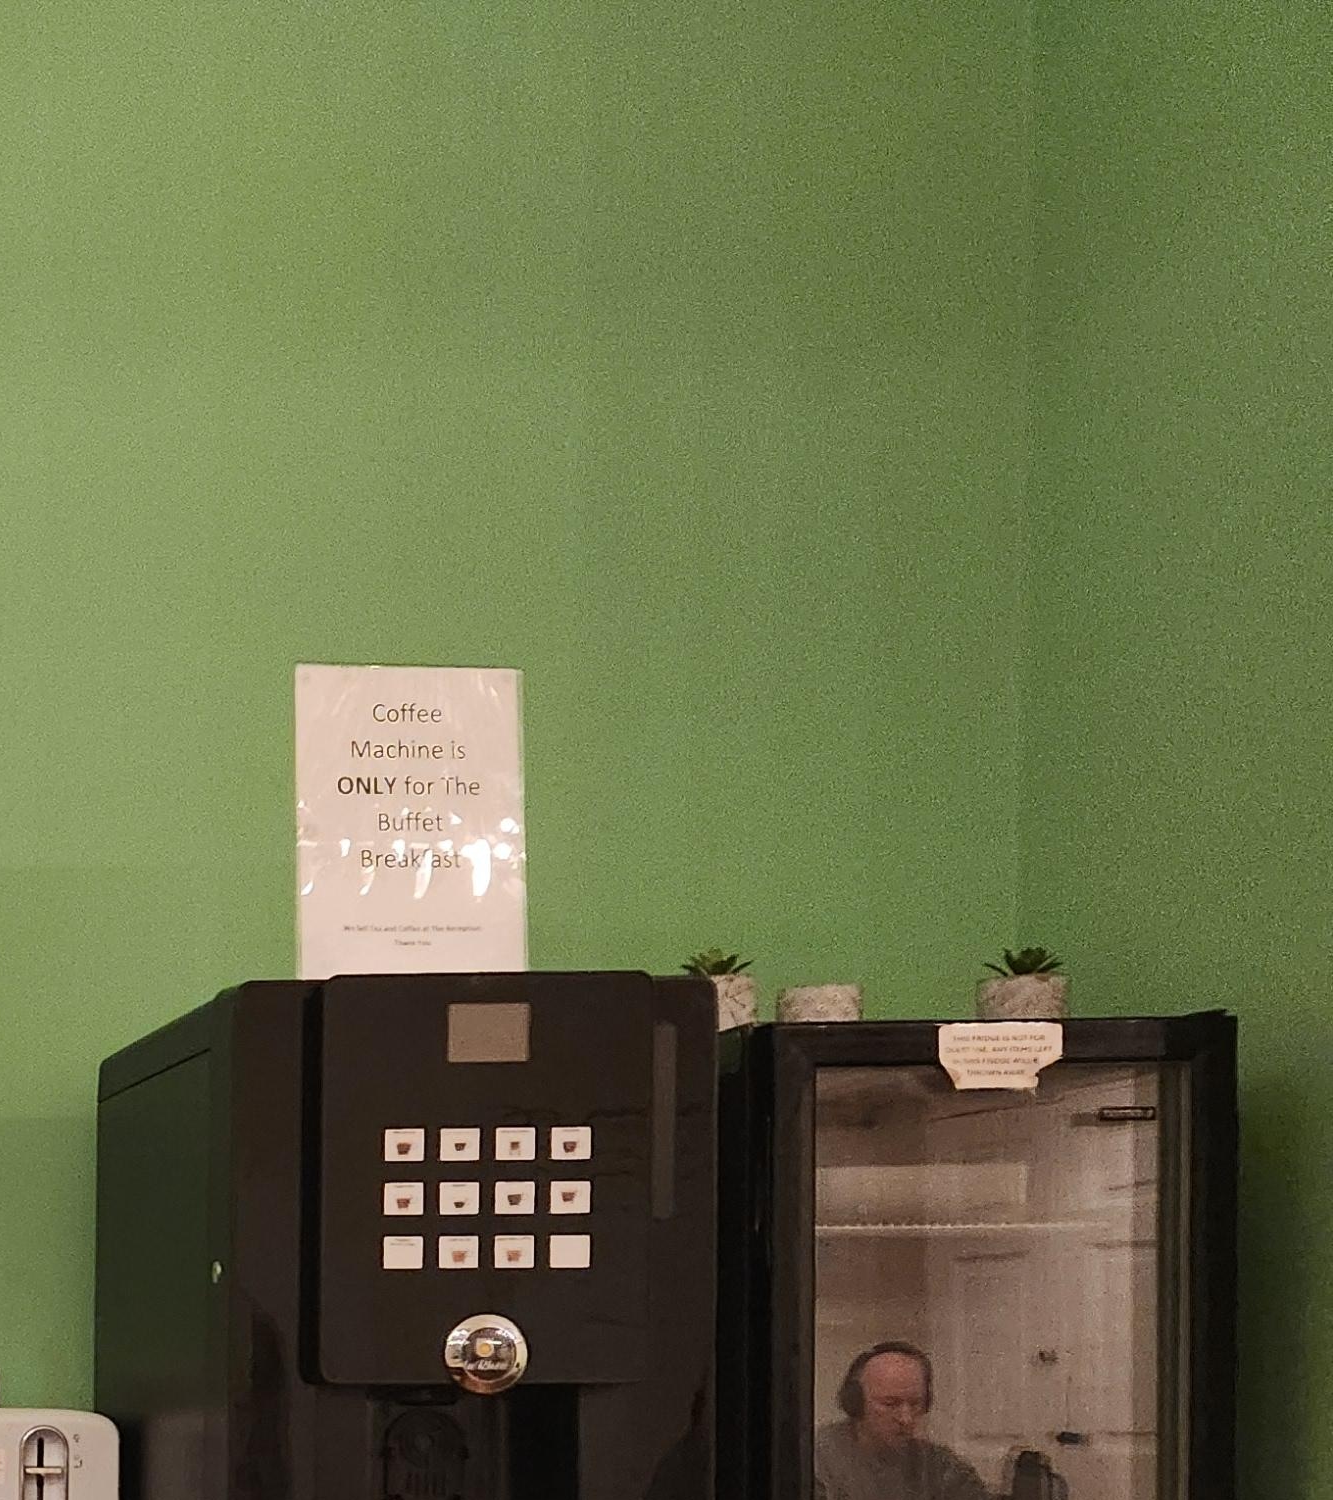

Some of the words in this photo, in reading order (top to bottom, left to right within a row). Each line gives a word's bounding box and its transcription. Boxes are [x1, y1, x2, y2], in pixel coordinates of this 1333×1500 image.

[372, 702, 443, 724] Coffee
[350, 739, 444, 760] Machine
[450, 739, 467, 760] is
[337, 775, 398, 796] ONLY
[404, 775, 435, 796] for
[440, 775, 481, 796] The
[378, 811, 444, 833] Buffet
